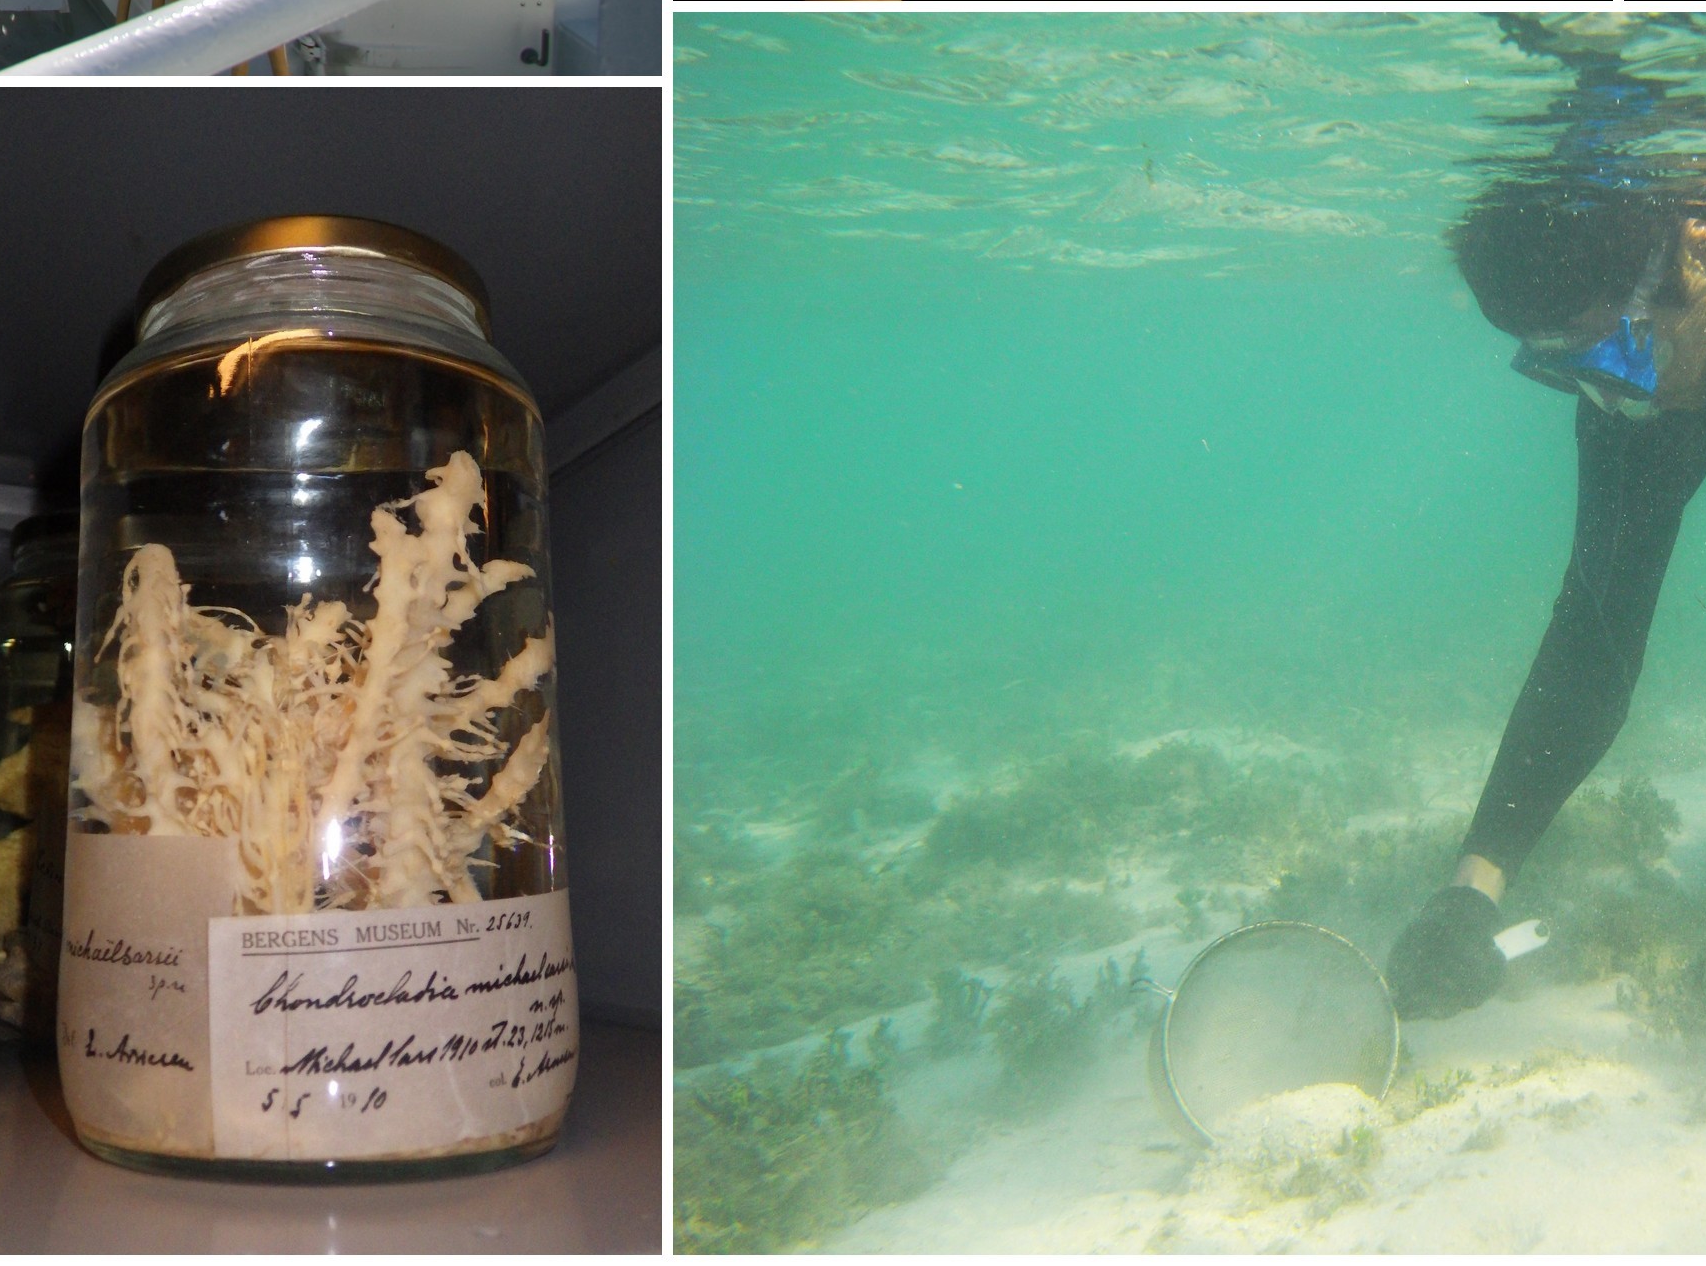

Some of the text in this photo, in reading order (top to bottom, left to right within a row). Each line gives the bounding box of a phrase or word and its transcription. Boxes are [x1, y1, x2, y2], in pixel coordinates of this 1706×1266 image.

[241, 928, 339, 950] BERGENS
[355, 920, 443, 944] MUSEUM
[456, 917, 480, 935] Nr.
